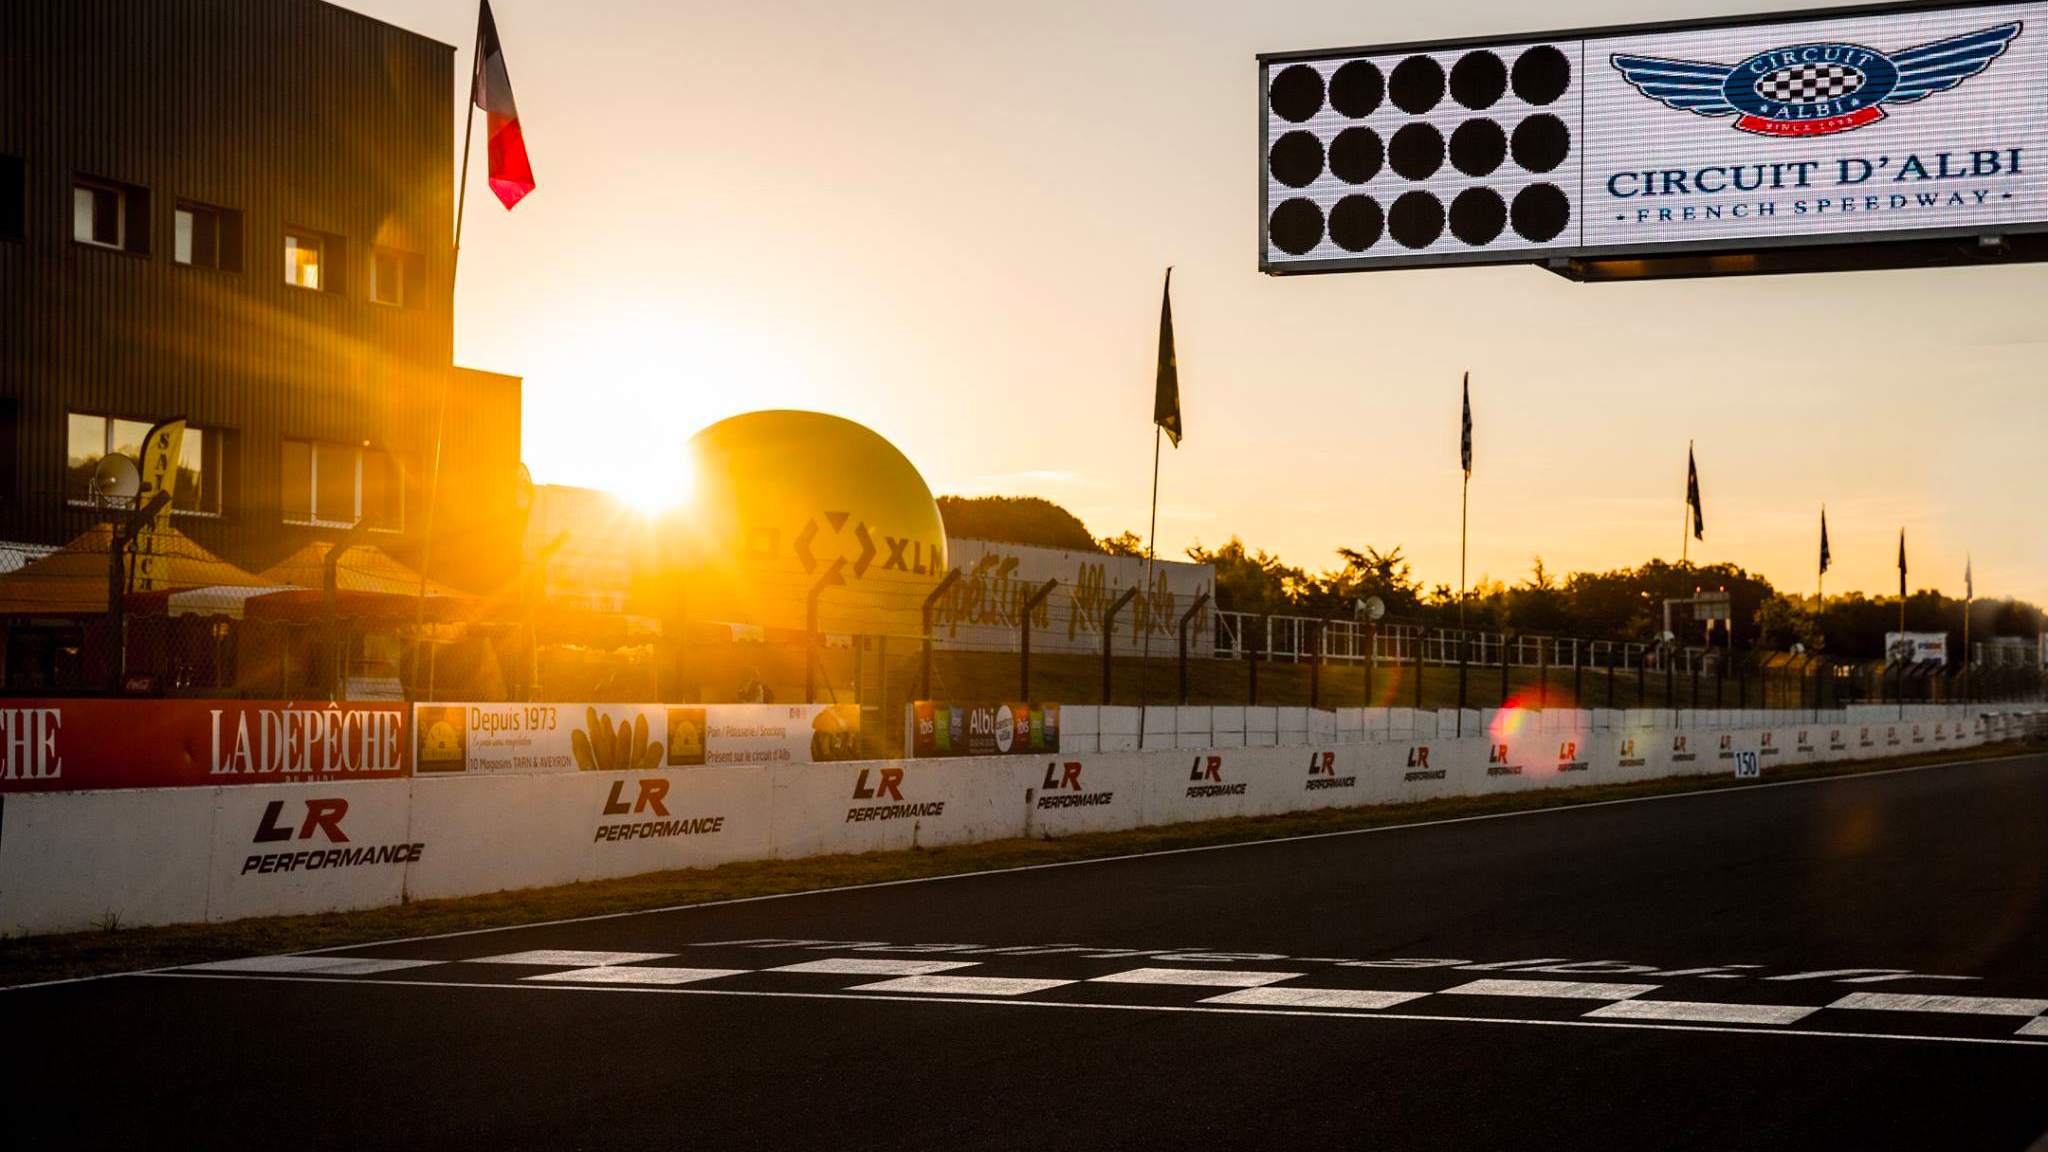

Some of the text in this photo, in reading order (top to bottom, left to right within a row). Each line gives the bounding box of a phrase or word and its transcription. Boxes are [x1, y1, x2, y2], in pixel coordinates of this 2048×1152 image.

[1749, 47, 1875, 74] CIRCUIT
[1773, 100, 1844, 119] ALBI
[1606, 148, 2024, 198] CIRCUIT D'ALBI
[1637, 189, 1989, 223] FRENCH SPEEDWAY
[471, 706, 557, 736] Depuis 1973
[969, 708, 995, 735] Albi
[0, 708, 62, 780] HE
[258, 700, 402, 774] DÉPÊCHE
[1308, 752, 1335, 776] LR
[1407, 747, 1429, 769] LR
[1488, 744, 1508, 764] LR
[1559, 742, 1576, 761] LR
[1736, 751, 1757, 775] 150
[1042, 762, 1082, 791] LR
[1189, 756, 1222, 782] LR
[602, 779, 671, 817] LR
[851, 768, 904, 801] LR
[1186, 783, 1247, 798] PERFORMANCE
[846, 802, 945, 823] PERFORMANCE
[1037, 792, 1114, 809] PERFORMANCE
[252, 798, 350, 843] LR
[594, 817, 725, 843] PERFORMANCE
[241, 842, 424, 876] PERFORMANCE
